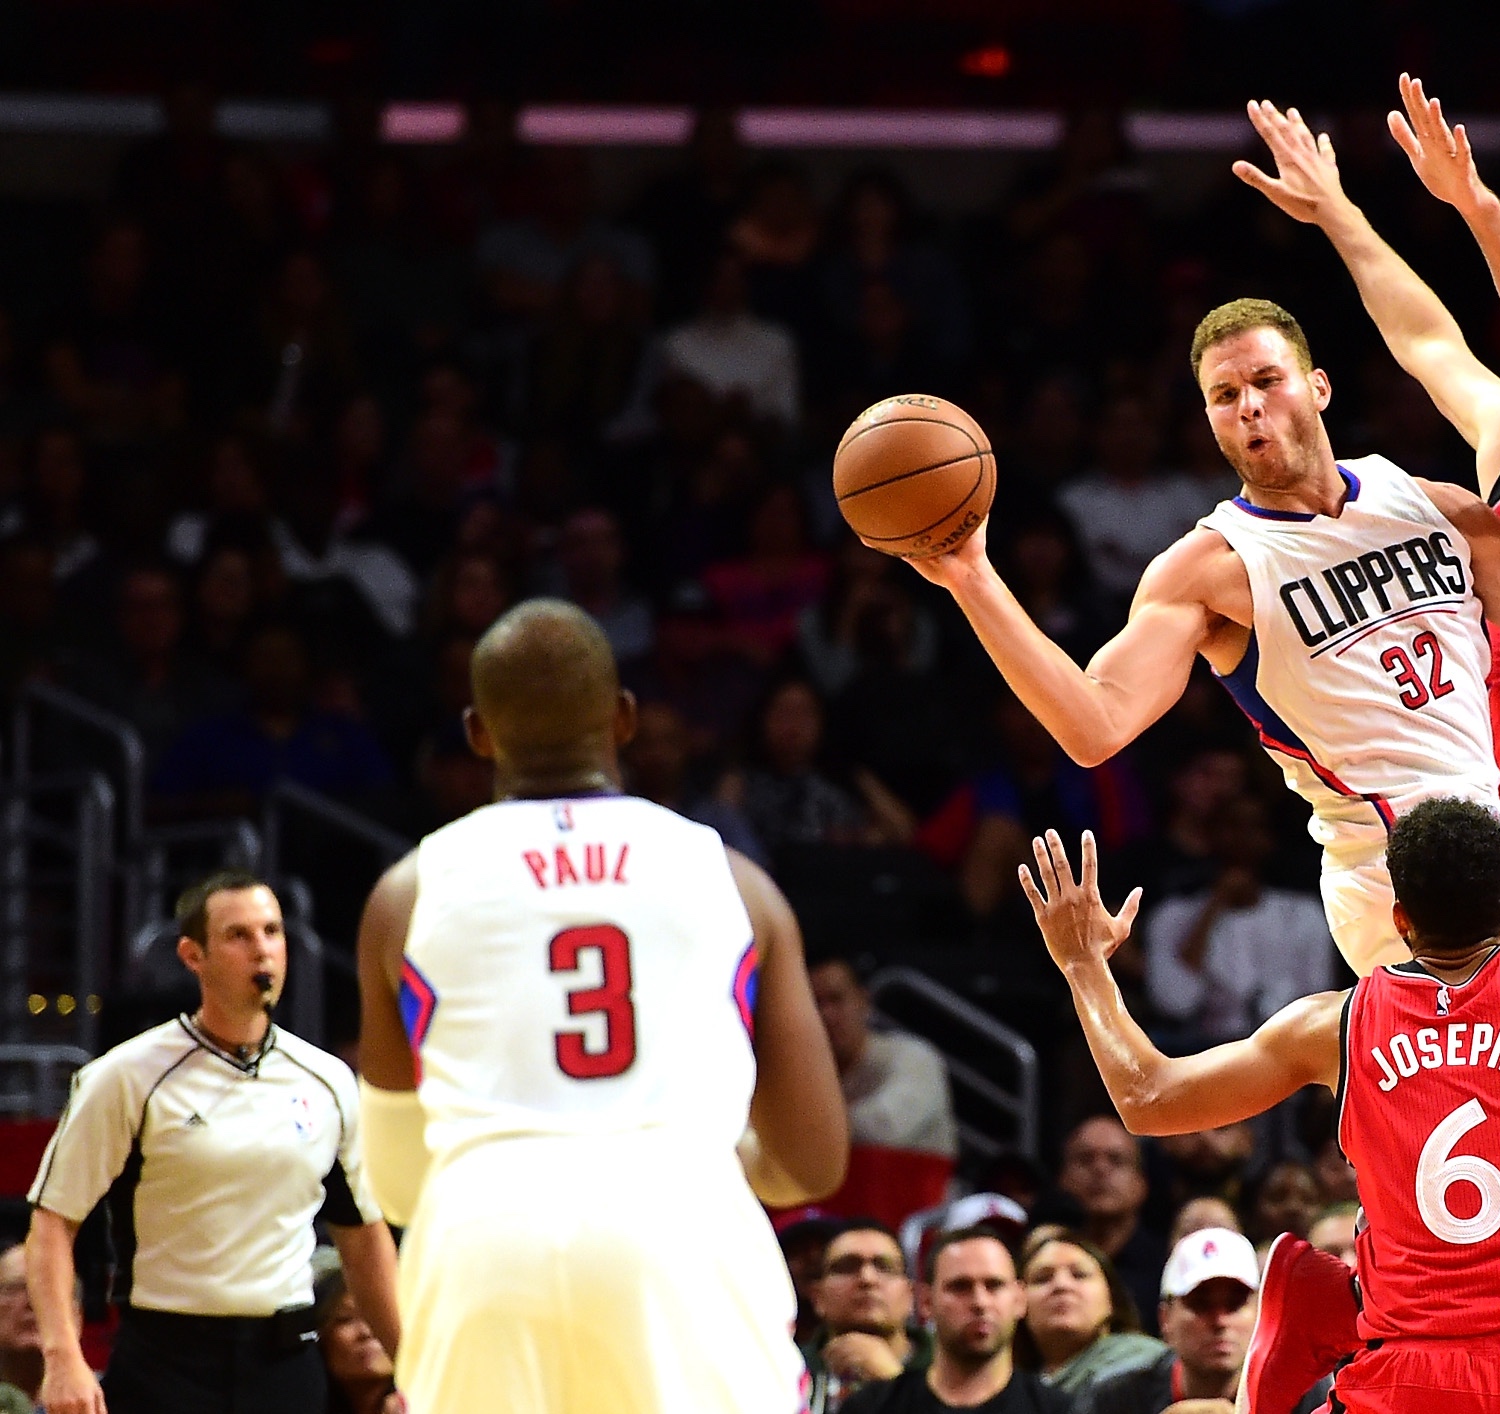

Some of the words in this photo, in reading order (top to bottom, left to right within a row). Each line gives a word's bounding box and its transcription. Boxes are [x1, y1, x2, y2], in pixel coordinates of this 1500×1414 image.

[1279, 531, 1466, 648] CLIPPERS
[1380, 630, 1455, 710] 32
[522, 843, 630, 889] PAUL
[548, 921, 637, 1080] 3
